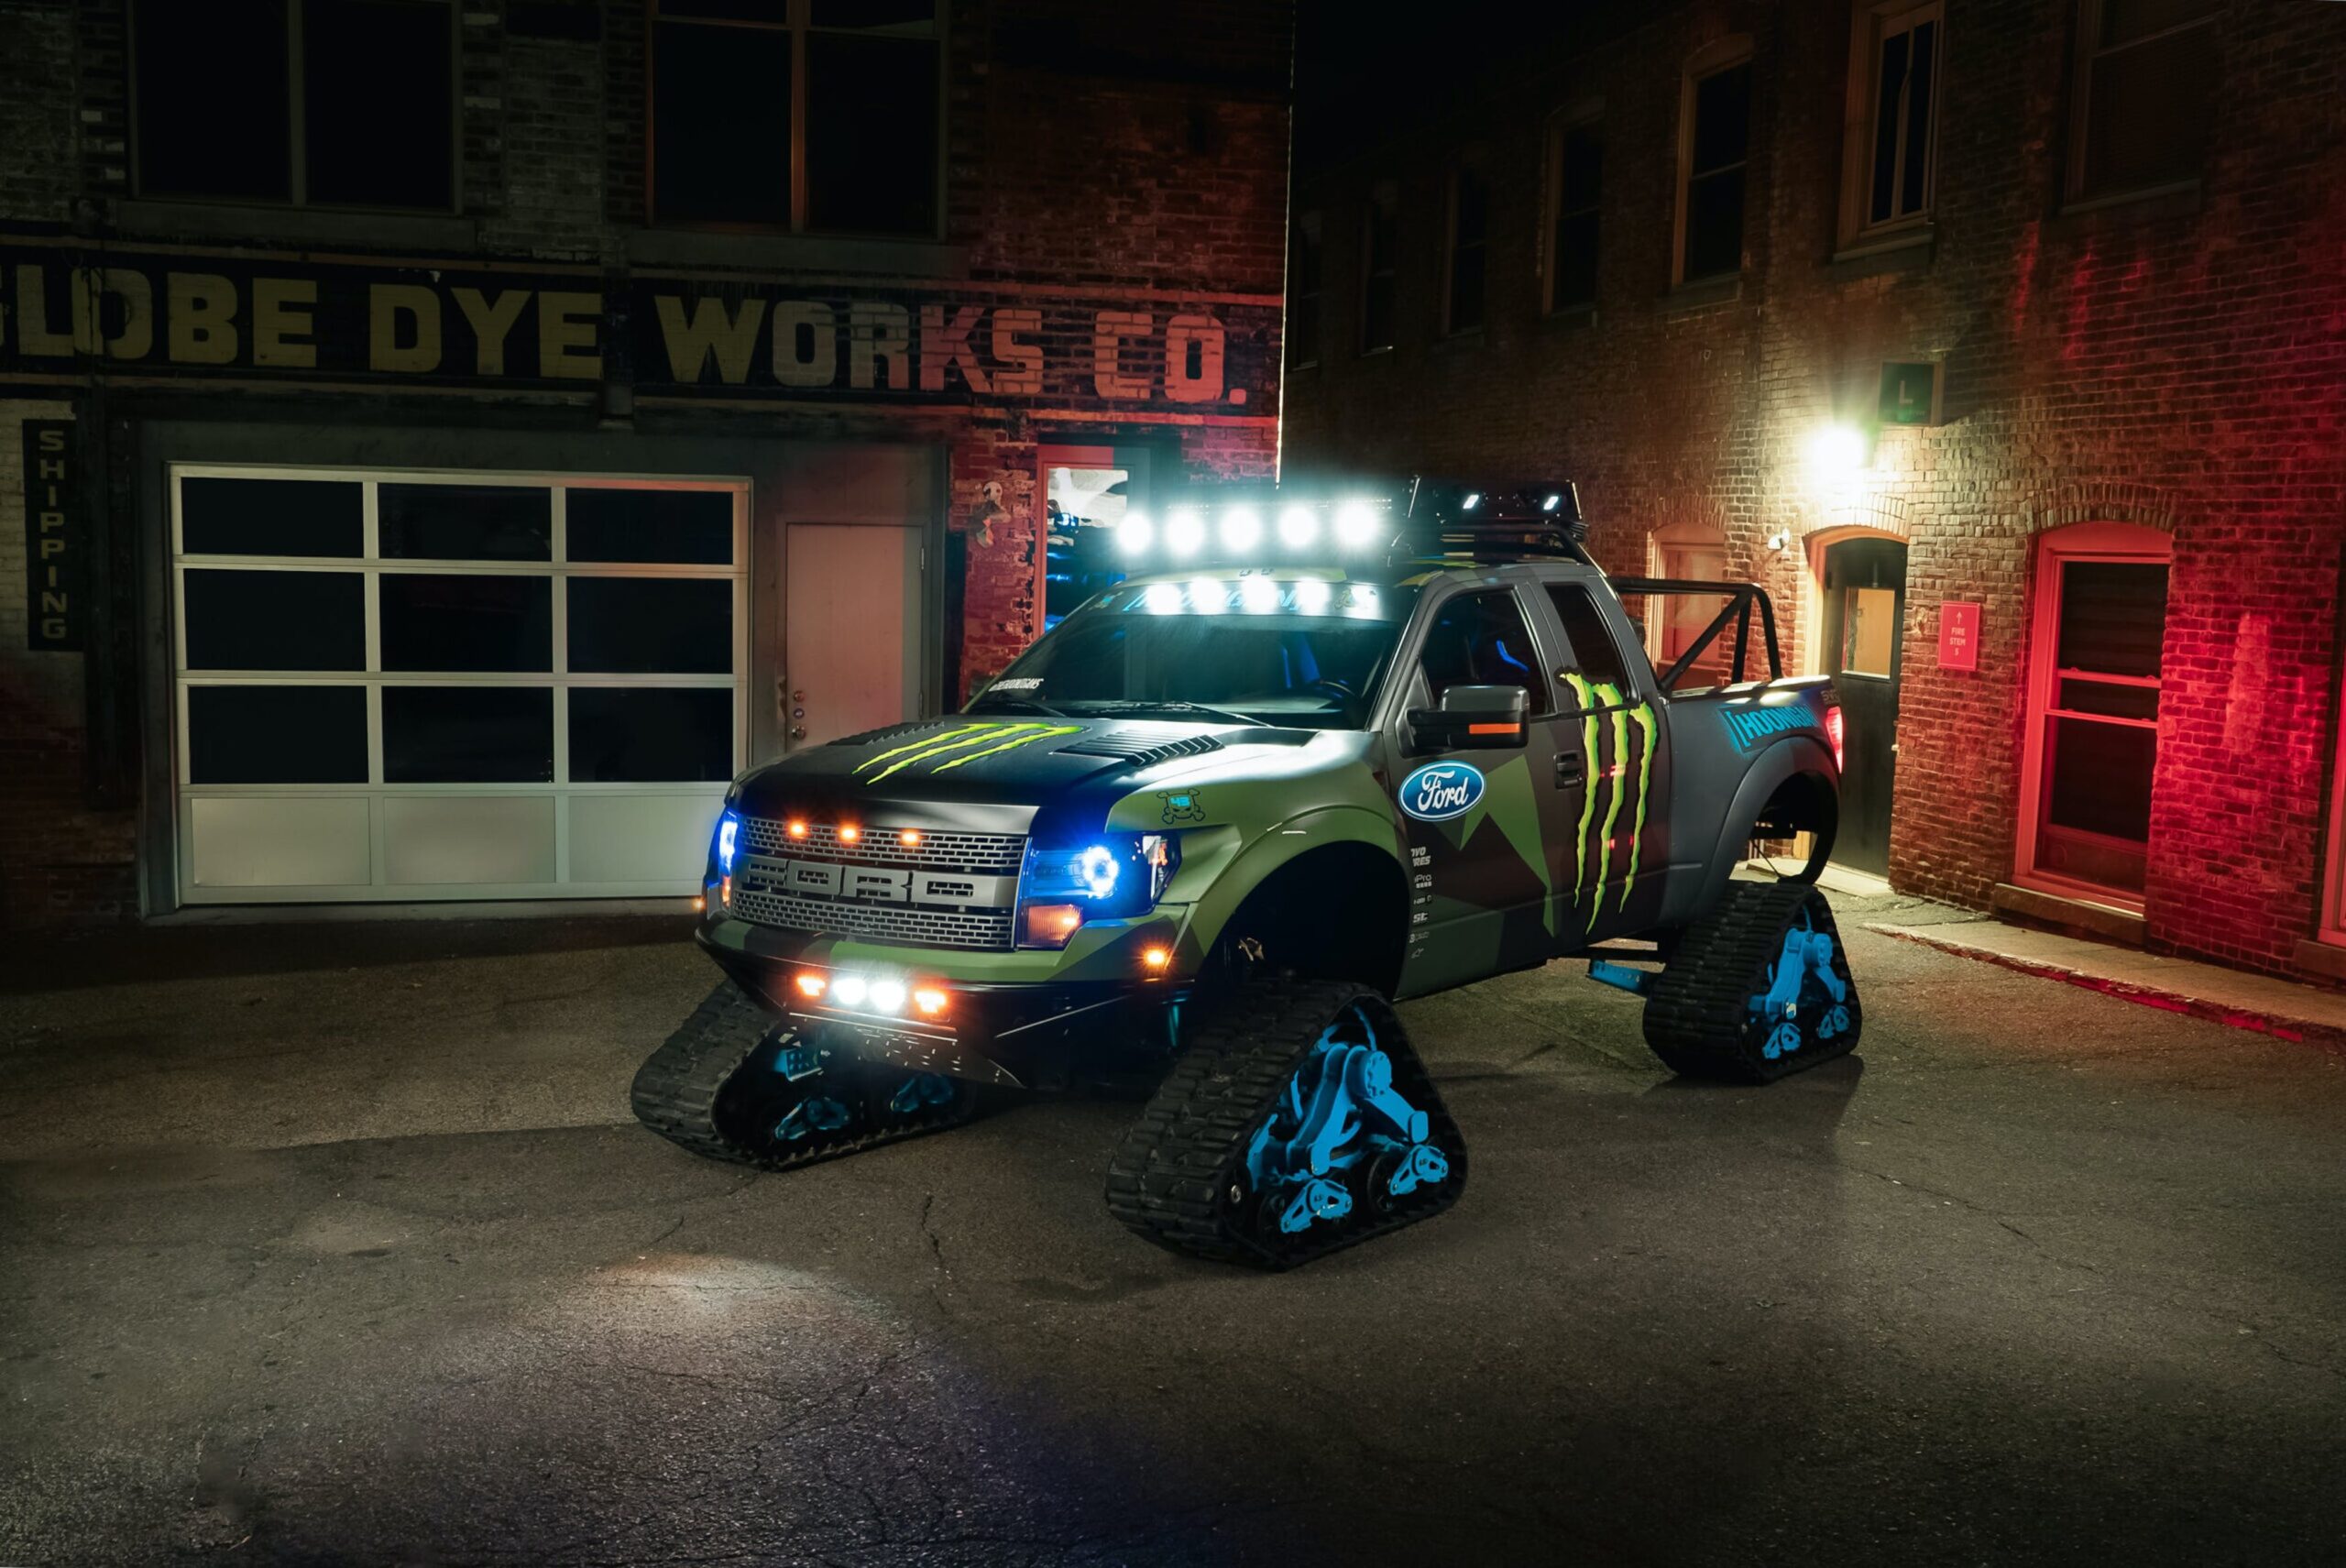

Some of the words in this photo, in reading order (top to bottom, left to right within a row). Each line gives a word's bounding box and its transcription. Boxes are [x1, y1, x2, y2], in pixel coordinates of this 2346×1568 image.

[0, 264, 318, 367] LOBE
[369, 283, 603, 380] DYE
[653, 294, 1045, 394] WORKS
[1094, 311, 1247, 405] CO.
[38, 430, 67, 641] SHIPPING
[1950, 627, 1966, 636] FIRE
[1418, 770, 1470, 812] Ford
[739, 853, 1009, 907] FORD
